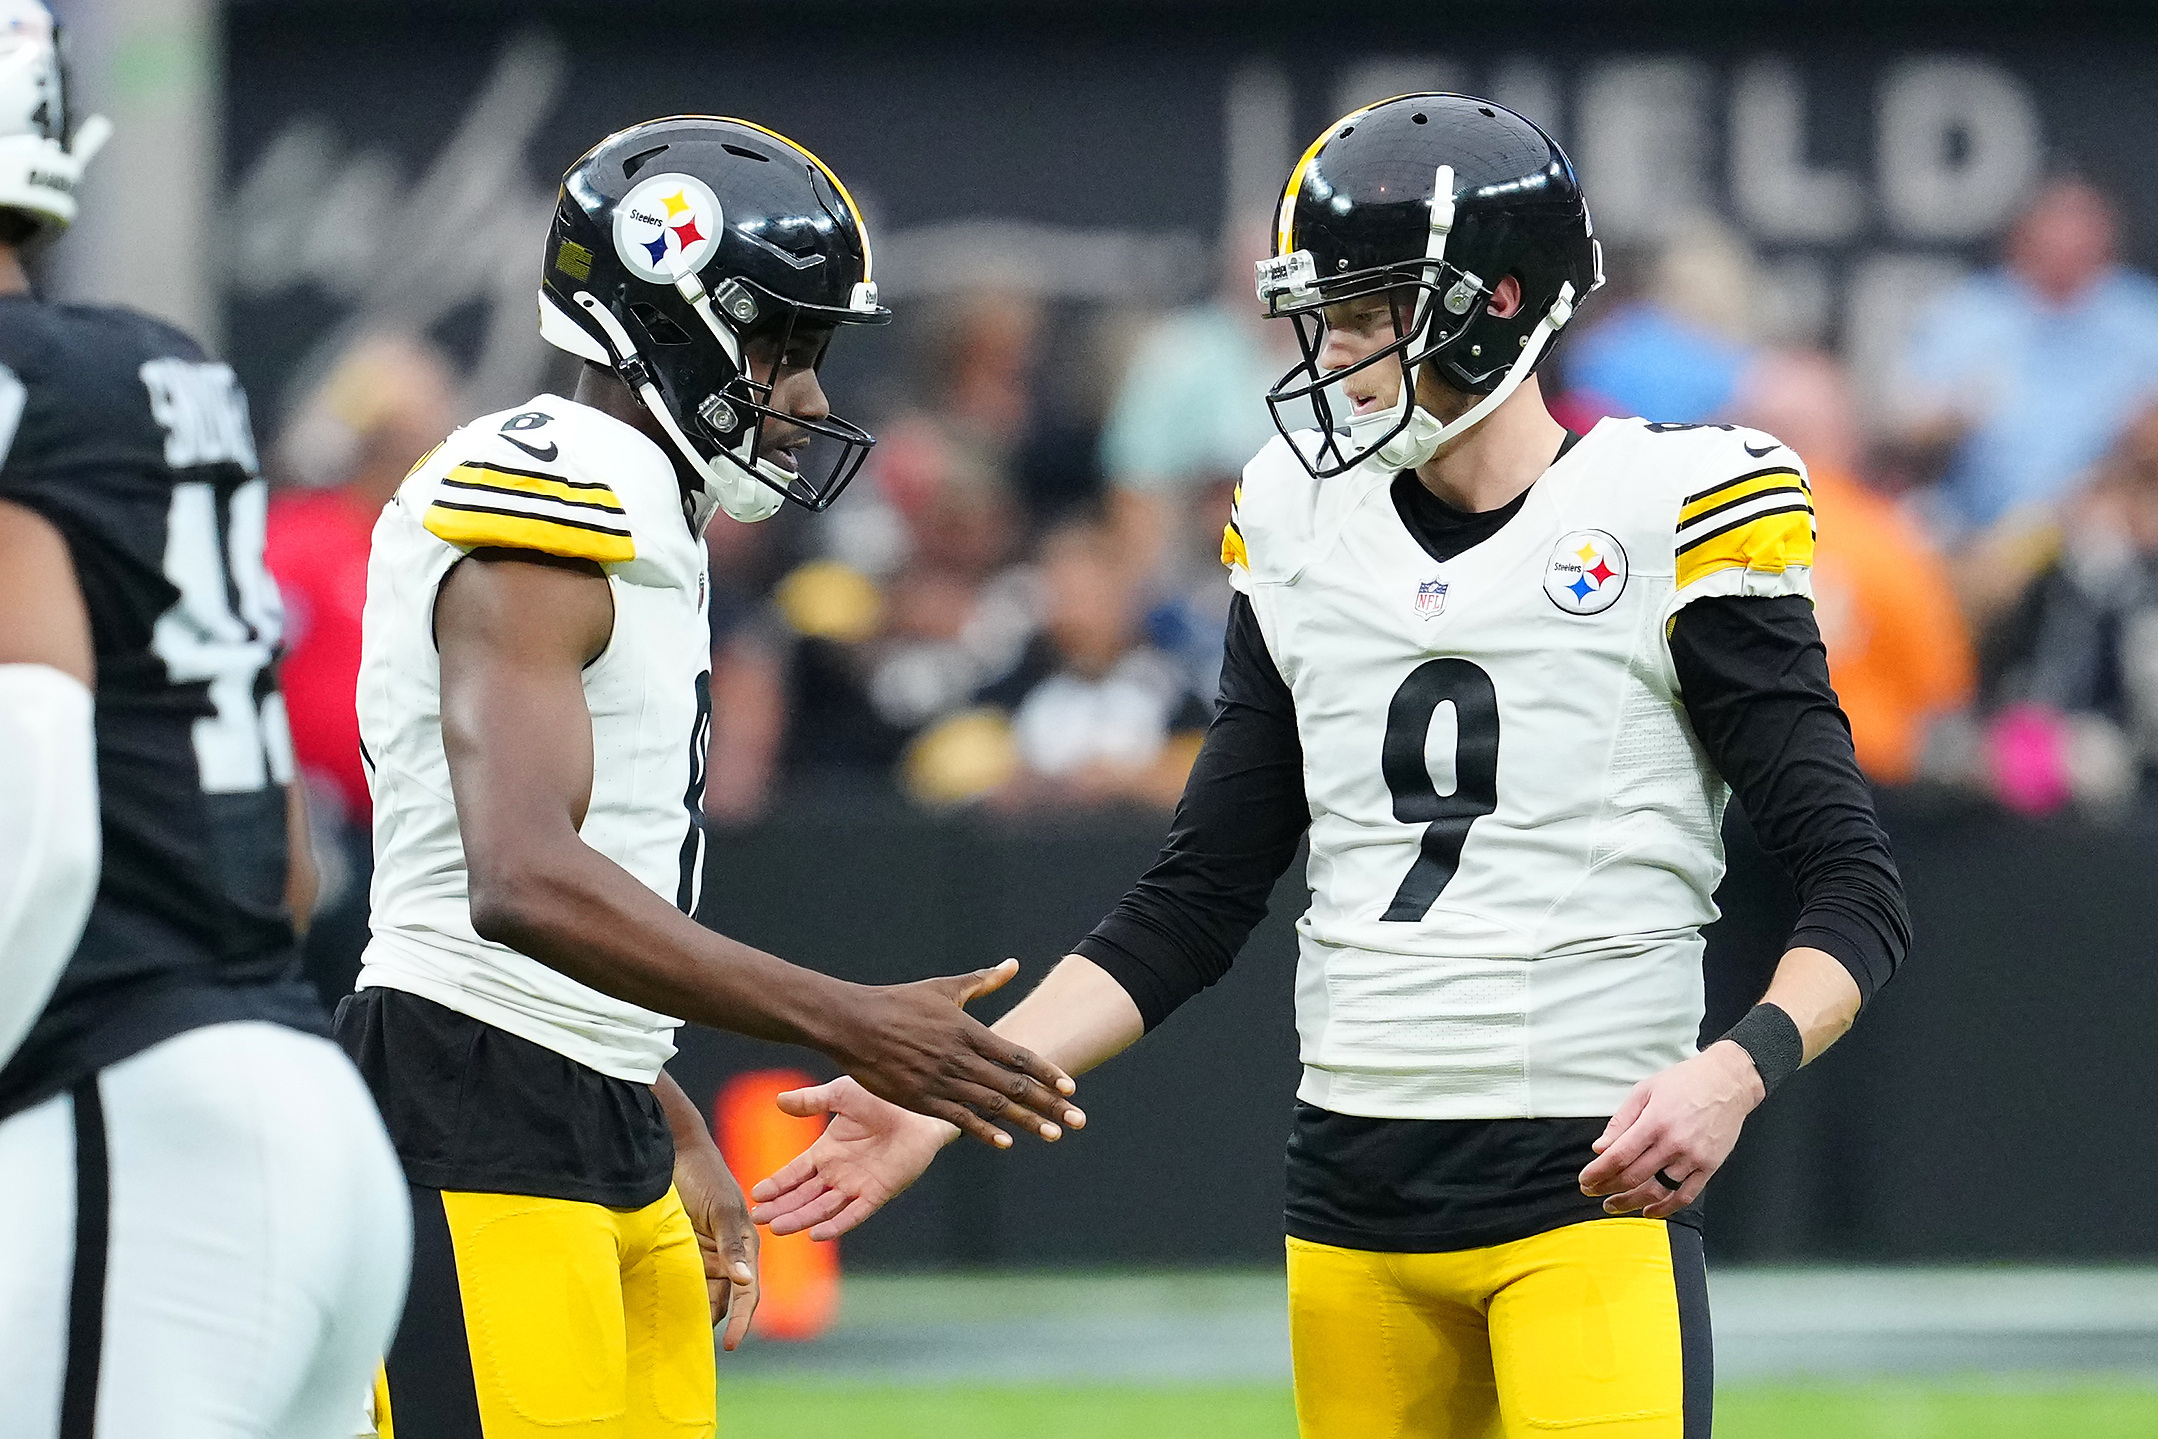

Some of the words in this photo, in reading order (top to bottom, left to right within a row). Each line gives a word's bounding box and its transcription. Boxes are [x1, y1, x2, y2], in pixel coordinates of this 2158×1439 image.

[629, 208, 664, 227] Steelers
[1553, 561, 1582, 573] Steelers
[1418, 593, 1441, 610] NFL
[1379, 657, 1501, 922] 9
